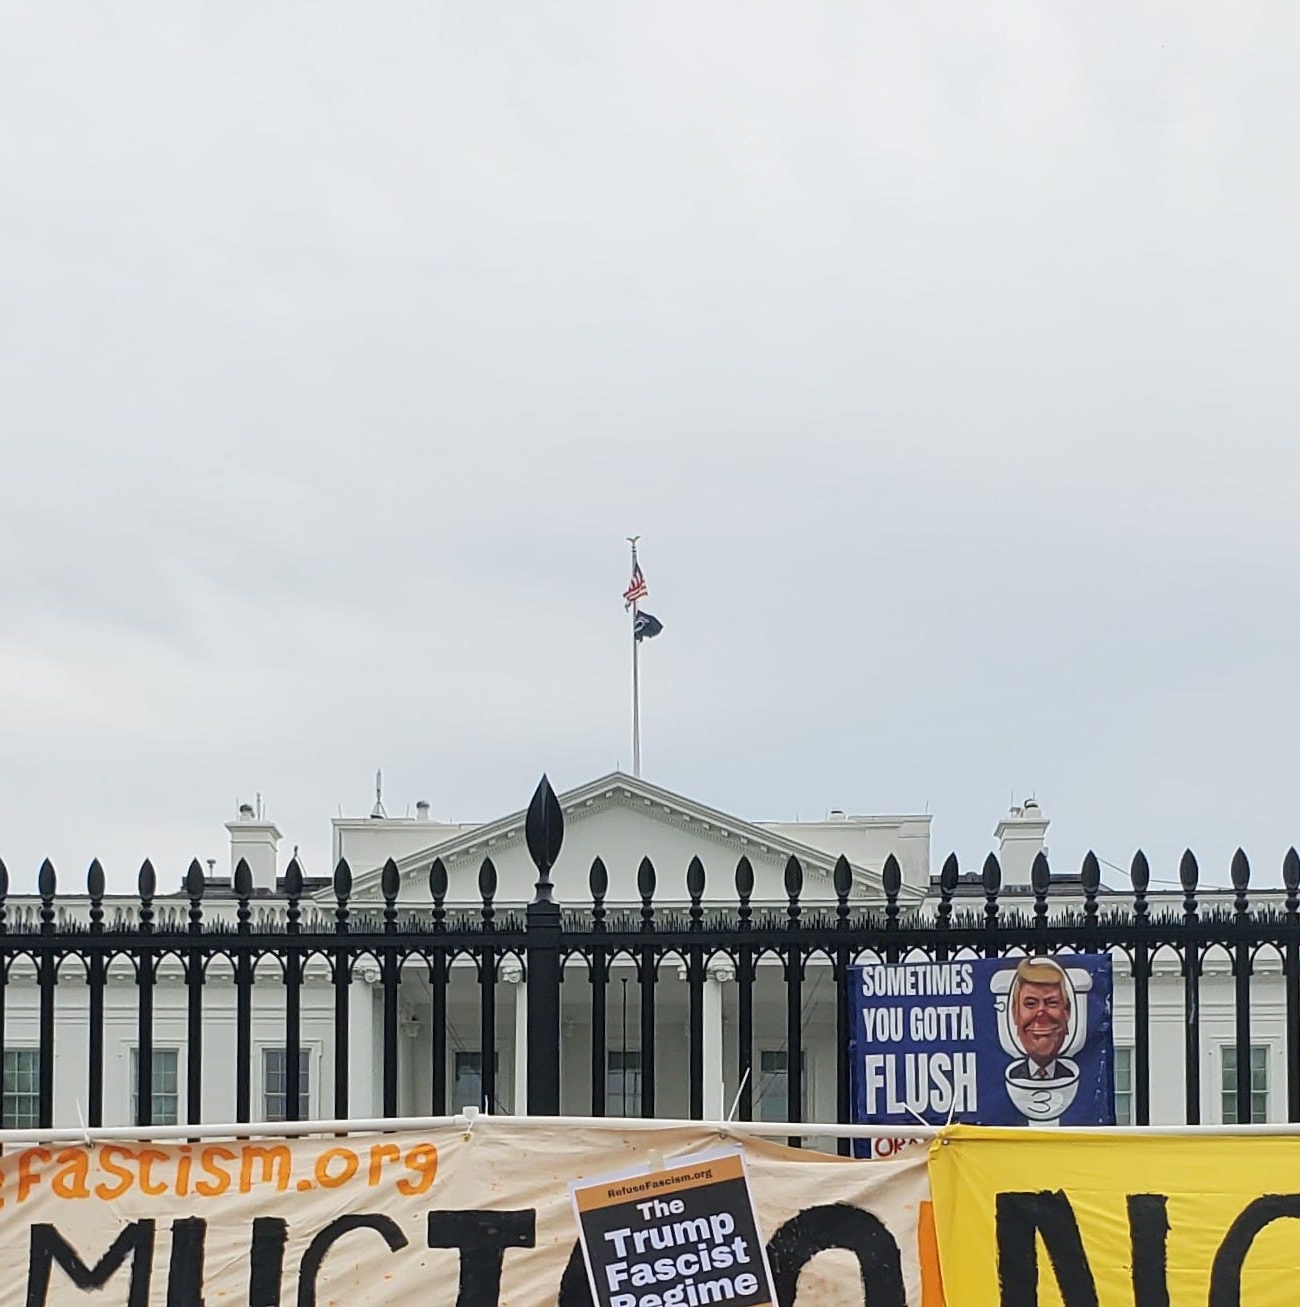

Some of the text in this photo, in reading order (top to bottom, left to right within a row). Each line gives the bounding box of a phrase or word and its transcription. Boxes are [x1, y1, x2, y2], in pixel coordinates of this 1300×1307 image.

[862, 964, 973, 997] SOMETIMES
[862, 1005, 974, 1043] YOU GOTTA
[865, 1052, 977, 1115] FLUSH
[607, 1168, 713, 1199] RefuseFascism.org
[636, 1198, 685, 1221] The
[604, 1211, 735, 1258] Trump
[605, 1235, 750, 1292] Fascist
